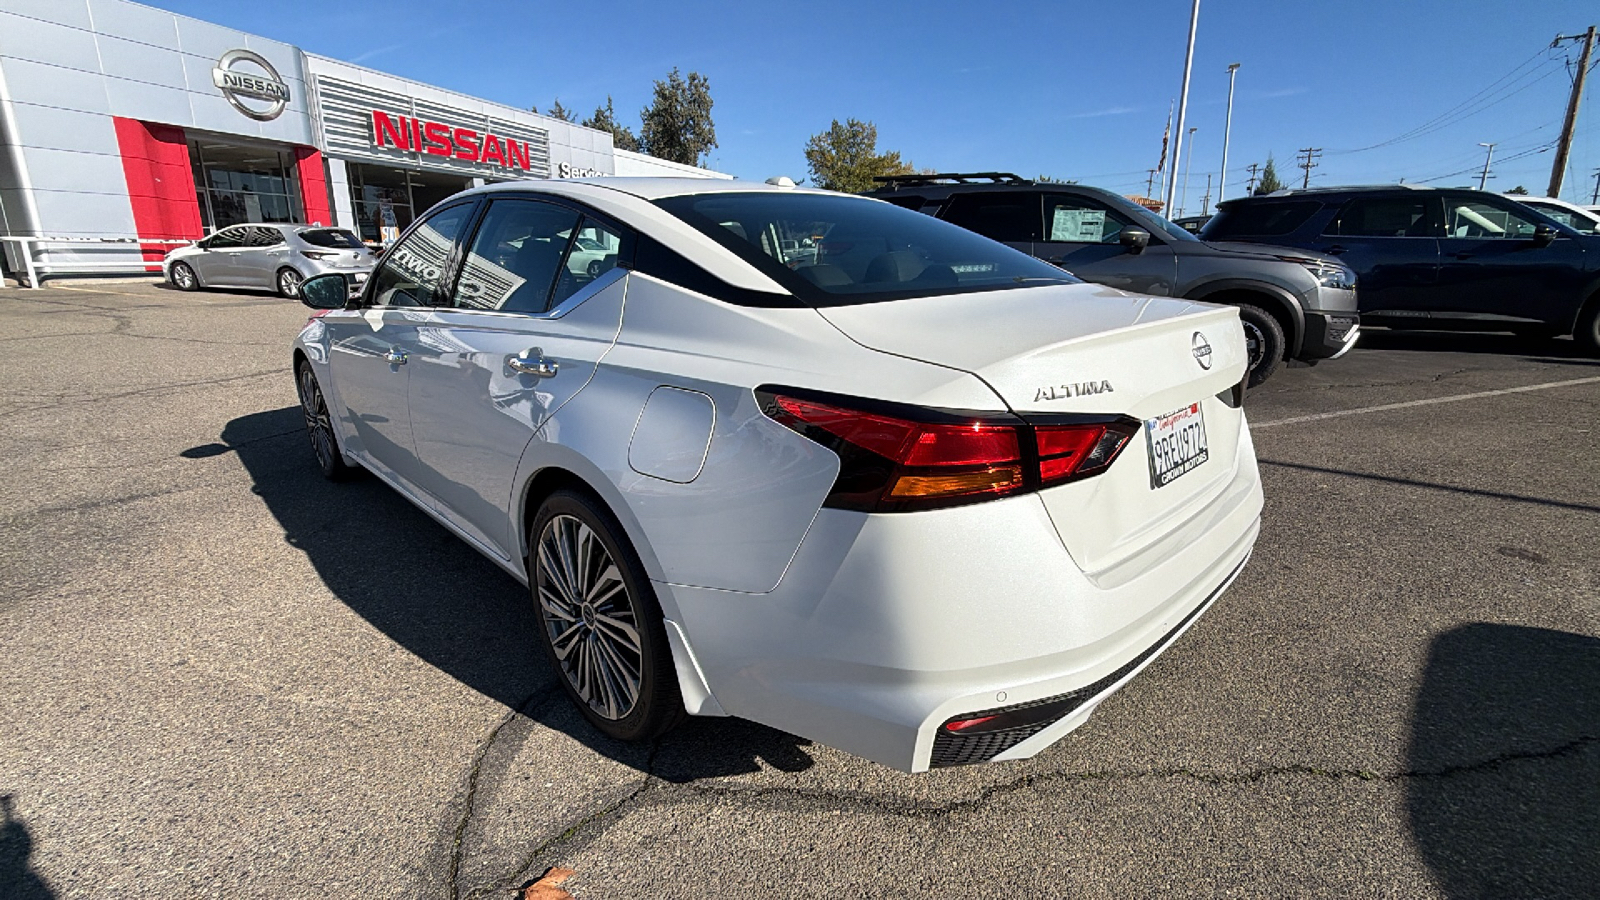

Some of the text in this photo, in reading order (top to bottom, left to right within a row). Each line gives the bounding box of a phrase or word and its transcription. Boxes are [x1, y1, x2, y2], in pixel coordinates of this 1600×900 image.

[223, 73, 287, 98] NISSAN
[372, 110, 531, 171] NISSAN
[1033, 379, 1114, 402] ALTIMA
[1154, 422, 1205, 475] 9REU972
[1161, 453, 1207, 484] CROWN MOTORS
